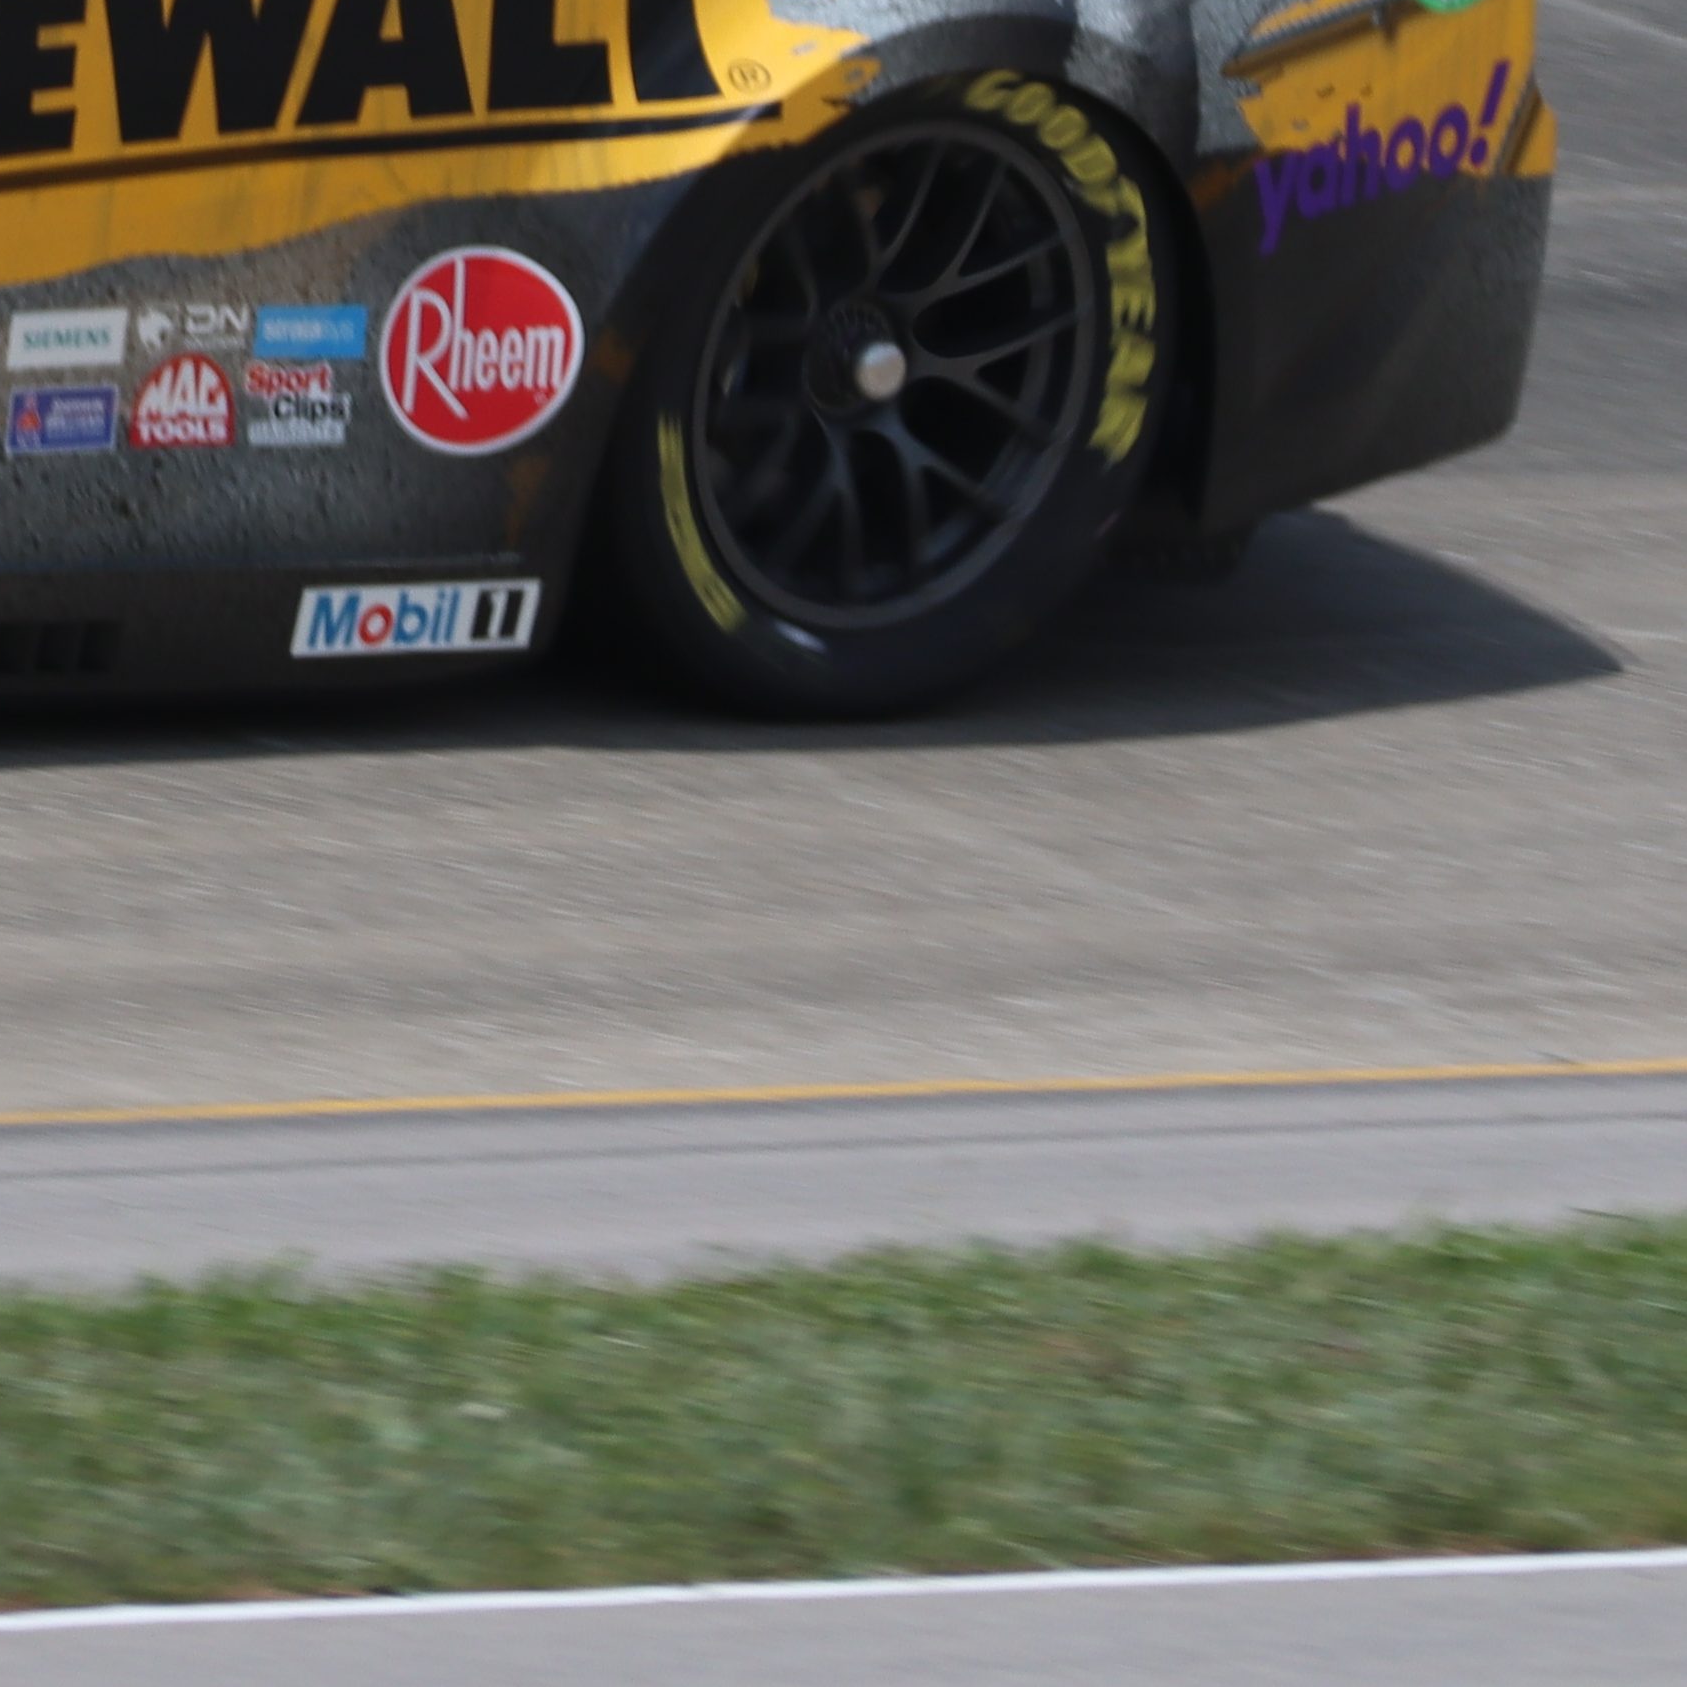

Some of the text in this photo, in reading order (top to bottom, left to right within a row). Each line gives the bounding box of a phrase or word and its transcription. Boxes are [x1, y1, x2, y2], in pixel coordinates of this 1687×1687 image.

[1254, 59, 1513, 256] yahoo!
[401, 255, 567, 421] Rheem
[137, 357, 229, 414] MAC
[245, 360, 334, 398] Sport
[271, 391, 354, 424] Clips
[137, 416, 229, 444] TOOLS
[306, 587, 517, 648] Mobil 1
